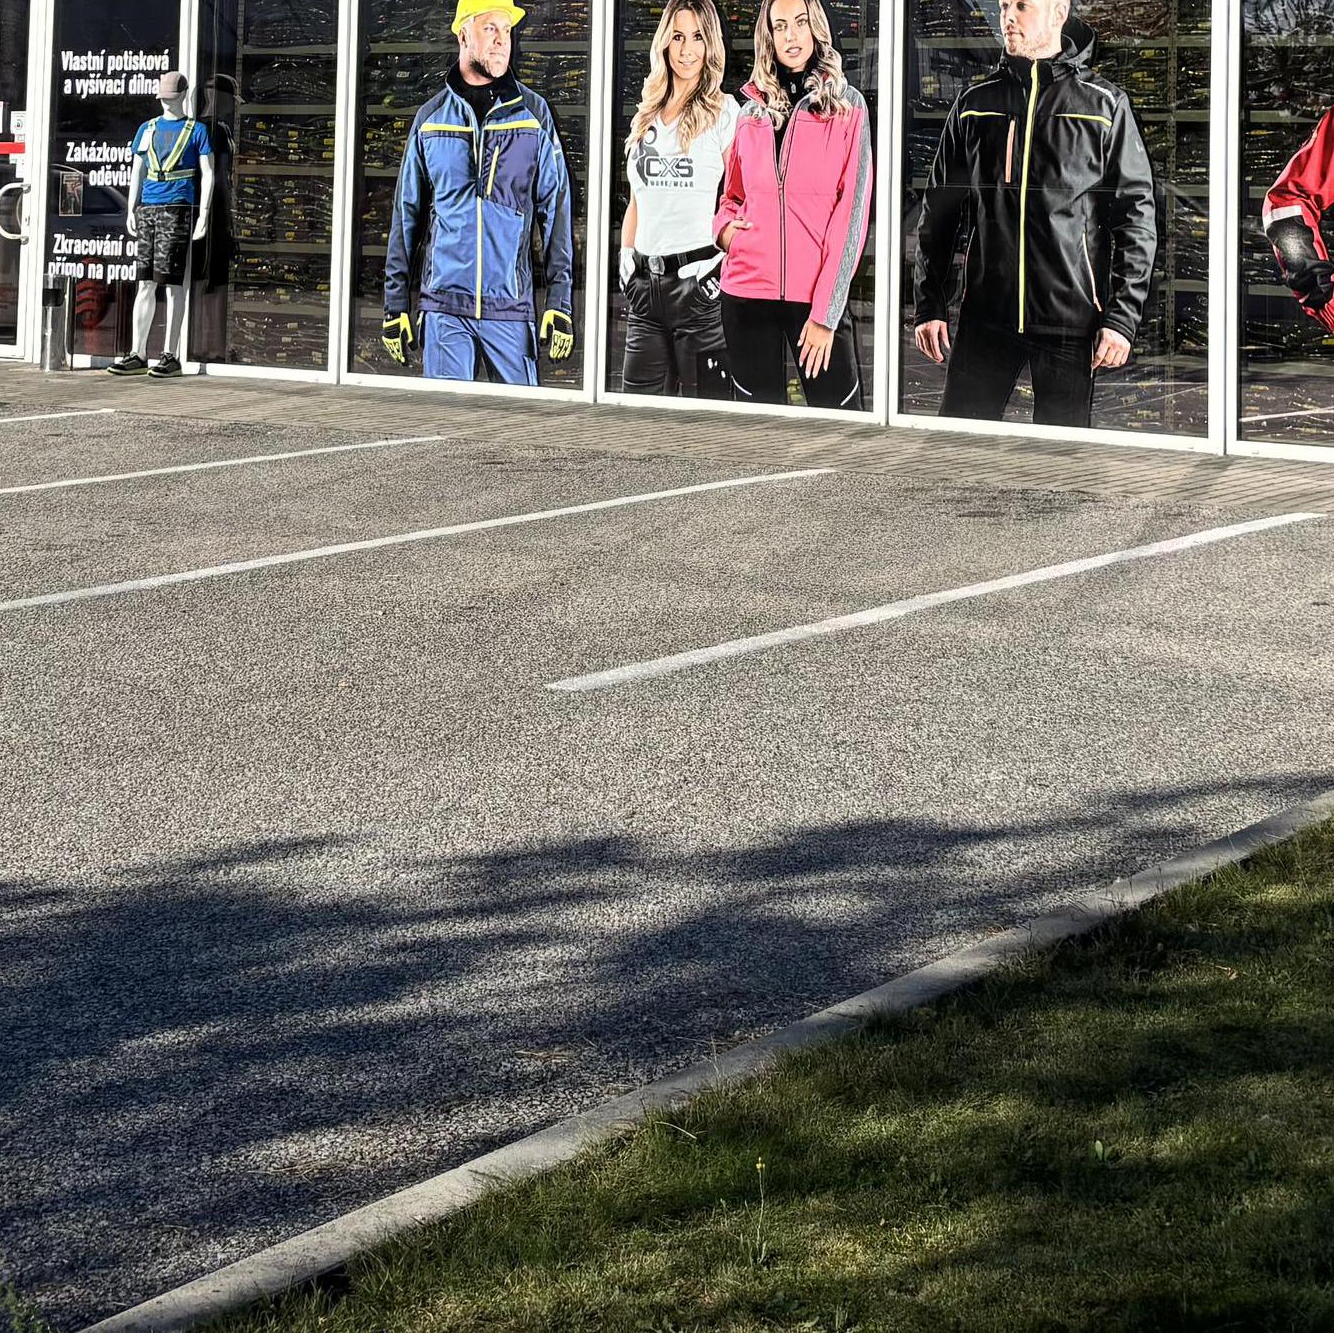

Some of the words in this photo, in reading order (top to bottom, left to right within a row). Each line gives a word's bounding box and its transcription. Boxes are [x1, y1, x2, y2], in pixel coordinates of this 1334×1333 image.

[61, 49, 105, 71] Vlastní
[107, 49, 170, 74] potisková
[64, 80, 72, 94] a
[75, 74, 125, 98] vyšívací
[65, 141, 133, 163] Zakázkové
[646, 158, 694, 178] CXS
[52, 233, 125, 256] Zkracování
[48, 257, 85, 279] přímo
[87, 265, 104, 280] na
